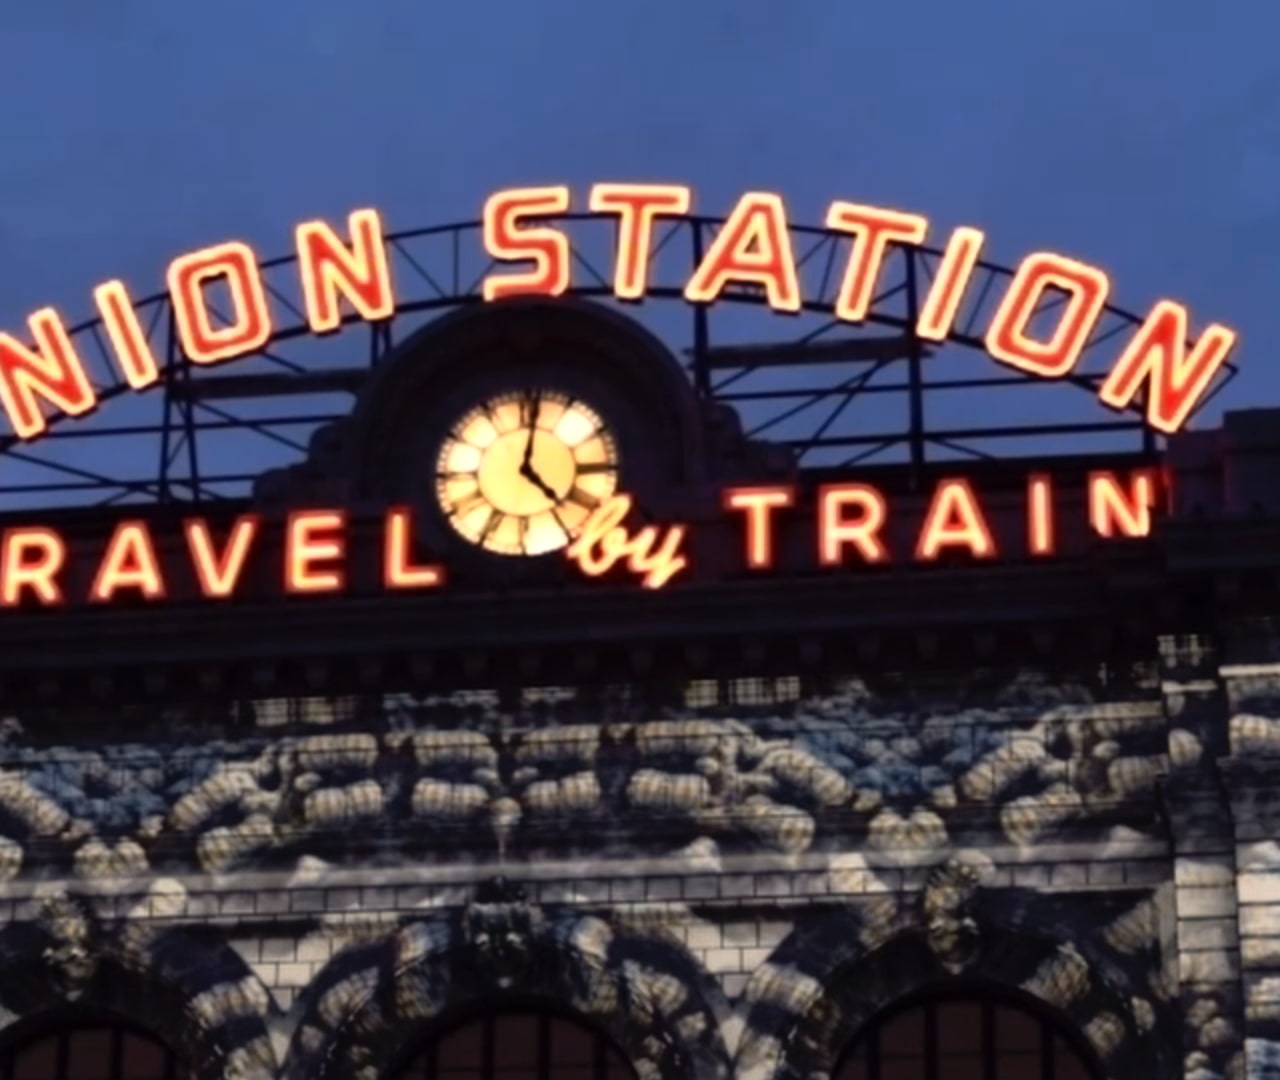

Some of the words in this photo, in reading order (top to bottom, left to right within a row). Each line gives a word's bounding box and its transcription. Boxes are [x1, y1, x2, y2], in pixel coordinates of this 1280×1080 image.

[482, 183, 1237, 434] STATION
[566, 492, 688, 590] by
[729, 469, 1157, 568] TRAIN
